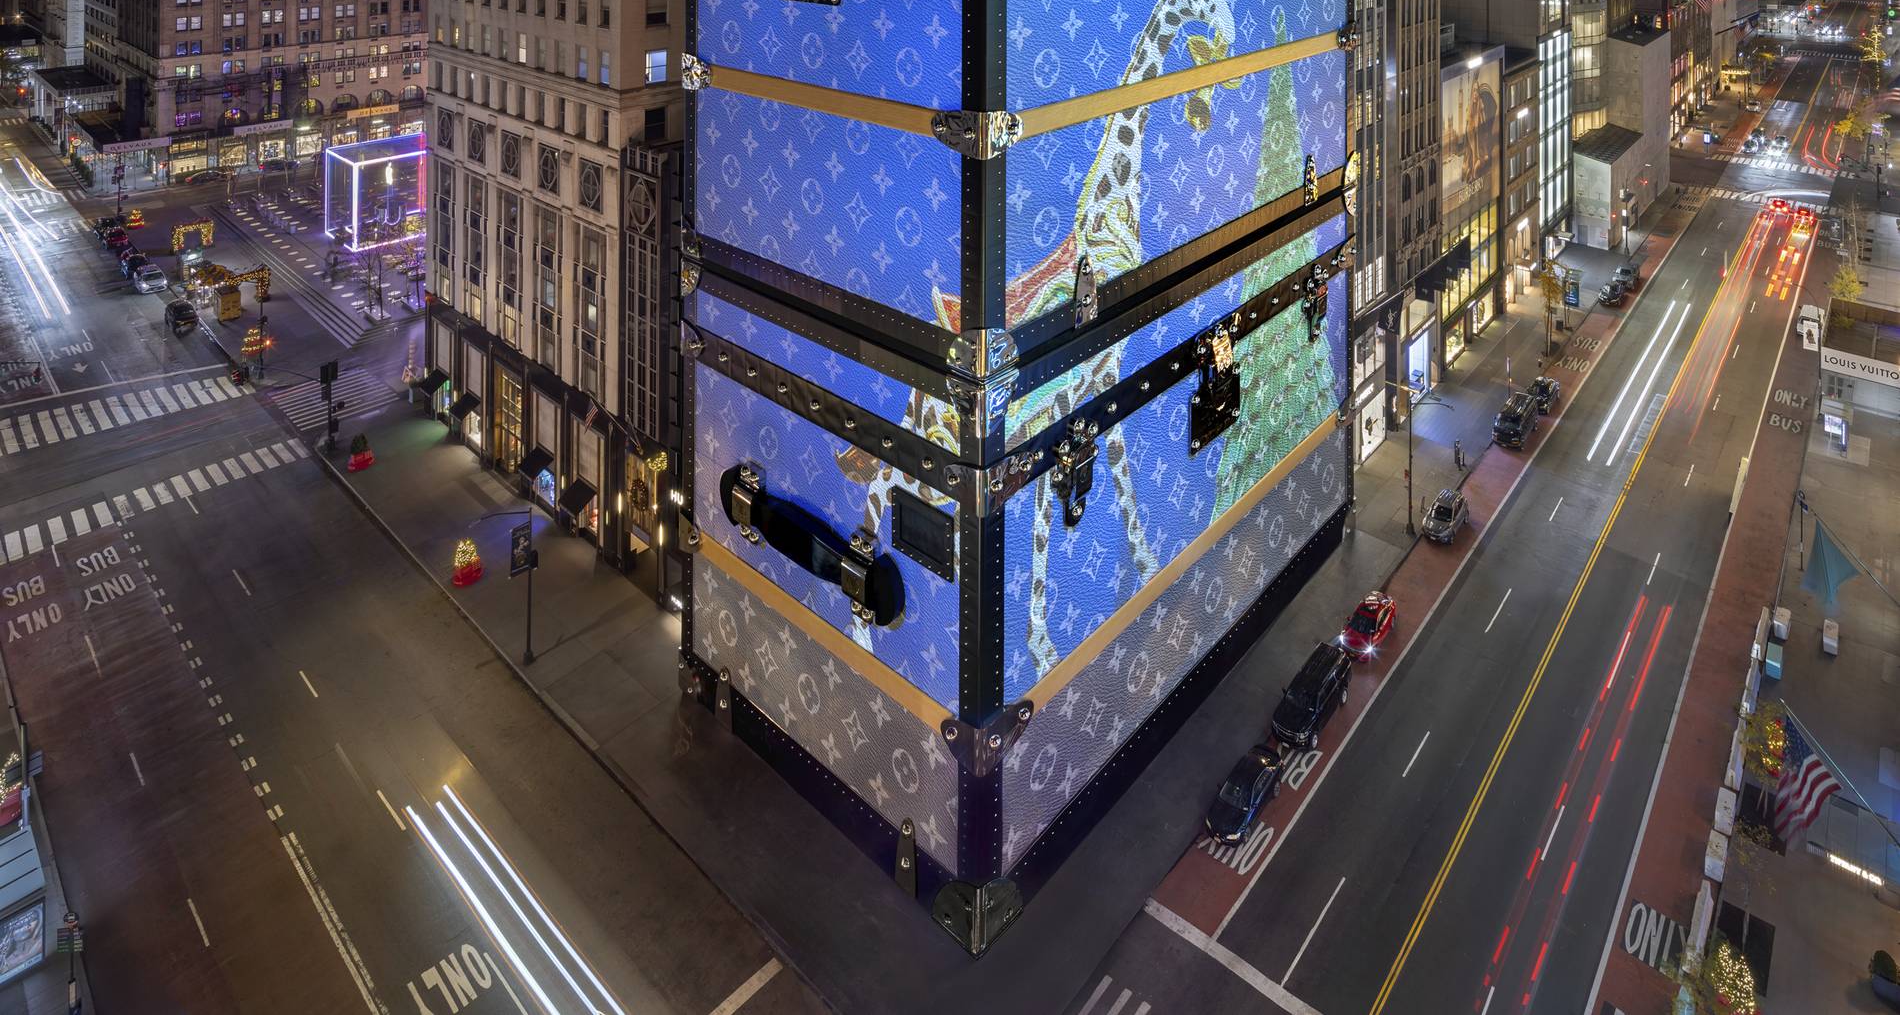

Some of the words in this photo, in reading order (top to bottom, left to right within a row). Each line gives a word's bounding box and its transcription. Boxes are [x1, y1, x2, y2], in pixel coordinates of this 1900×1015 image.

[49, 341, 94, 361] ONLY
[1574, 337, 1602, 352] BUS
[1555, 355, 1590, 373] ONLY
[1824, 355, 1856, 369] LOUIS
[1774, 389, 1808, 409] ONLY
[1769, 413, 1802, 433] BUS
[76, 546, 120, 576] BUS
[2, 575, 46, 606] BUS
[84, 573, 136, 611] ONLY
[8, 603, 62, 642] ONLY
